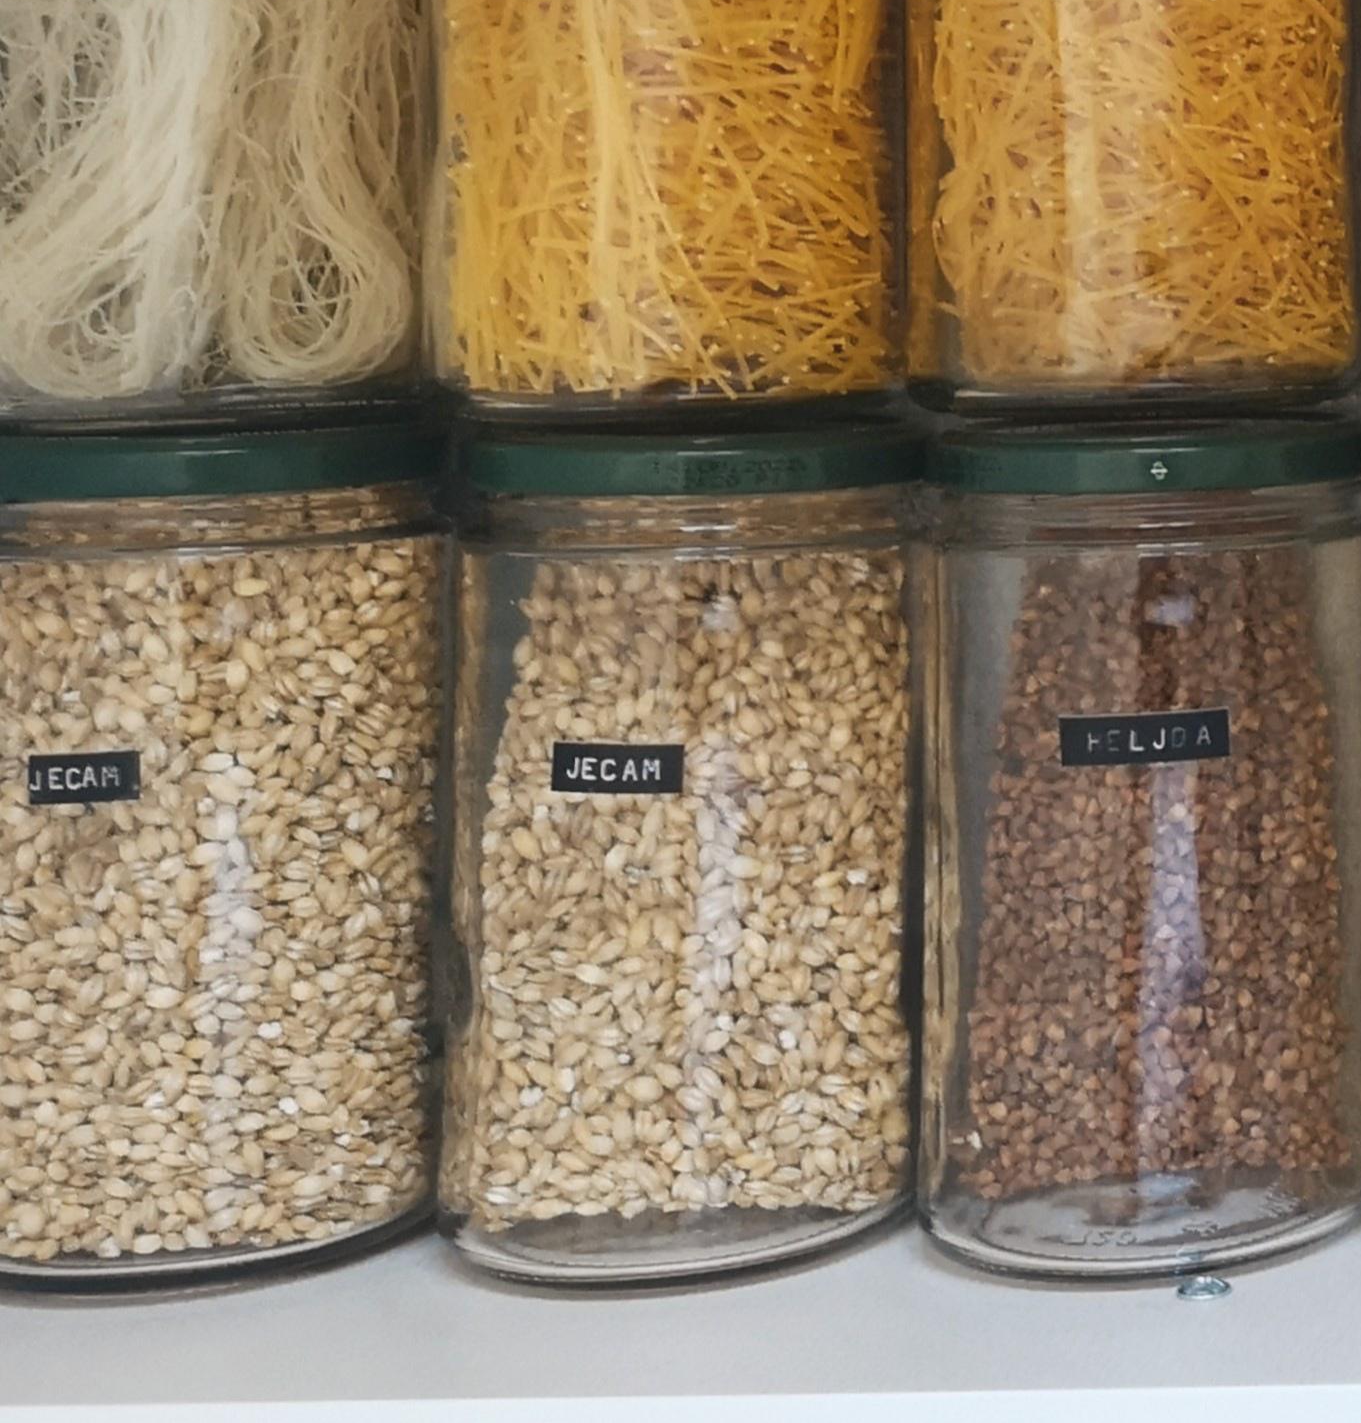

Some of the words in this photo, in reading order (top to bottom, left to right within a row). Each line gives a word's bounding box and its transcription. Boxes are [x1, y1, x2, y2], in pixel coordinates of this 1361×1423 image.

[1086, 723, 1213, 754] HELJDA
[29, 765, 120, 792] JECAM
[565, 756, 662, 782] JECAM
